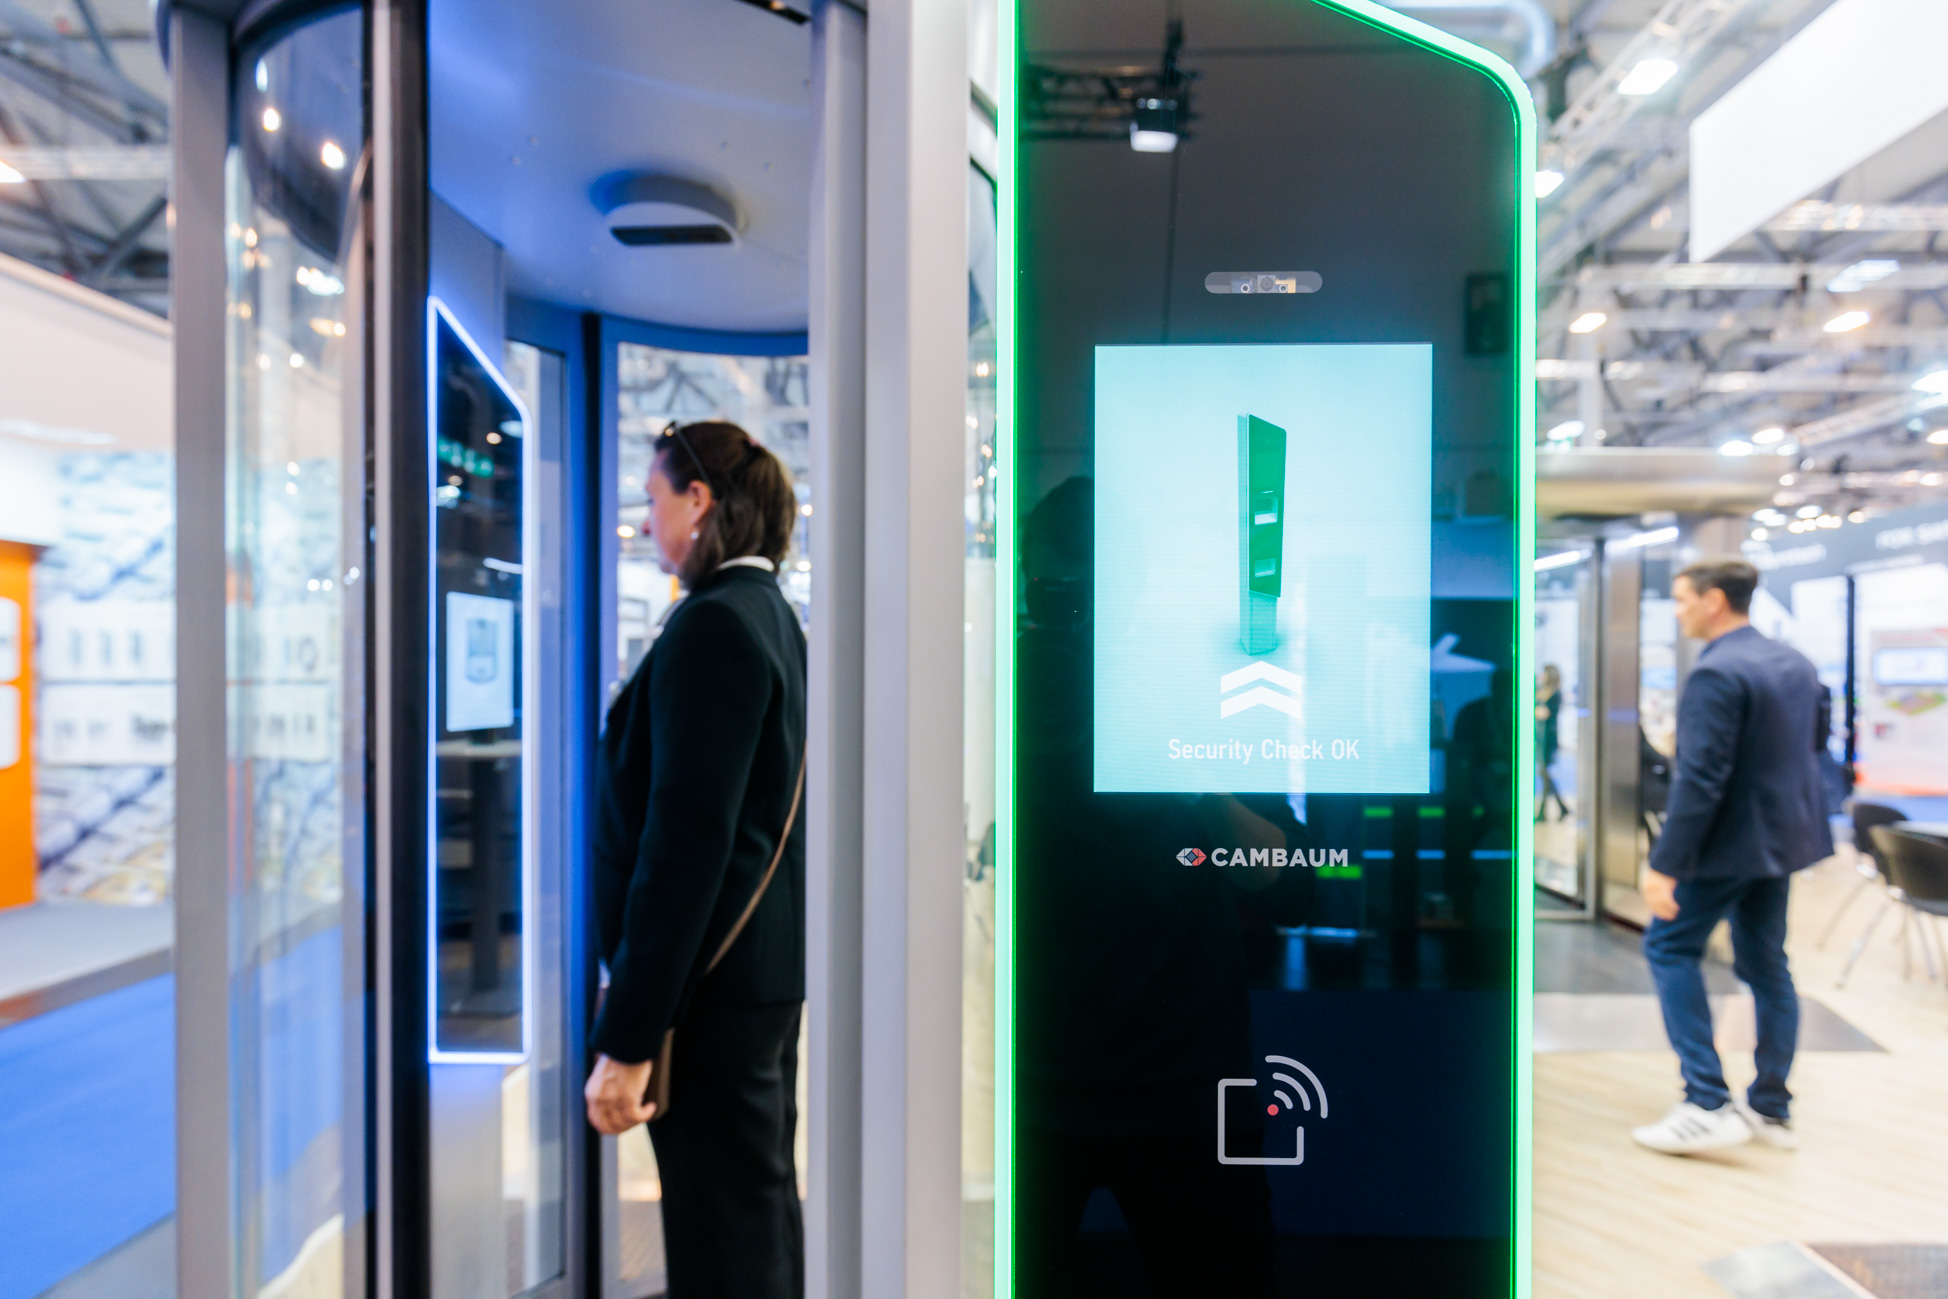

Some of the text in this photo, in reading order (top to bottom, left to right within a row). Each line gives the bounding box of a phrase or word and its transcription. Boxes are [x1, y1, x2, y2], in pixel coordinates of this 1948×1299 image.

[1168, 738, 1360, 765] Security Check OK
[1210, 847, 1348, 867] CAMBAUM
